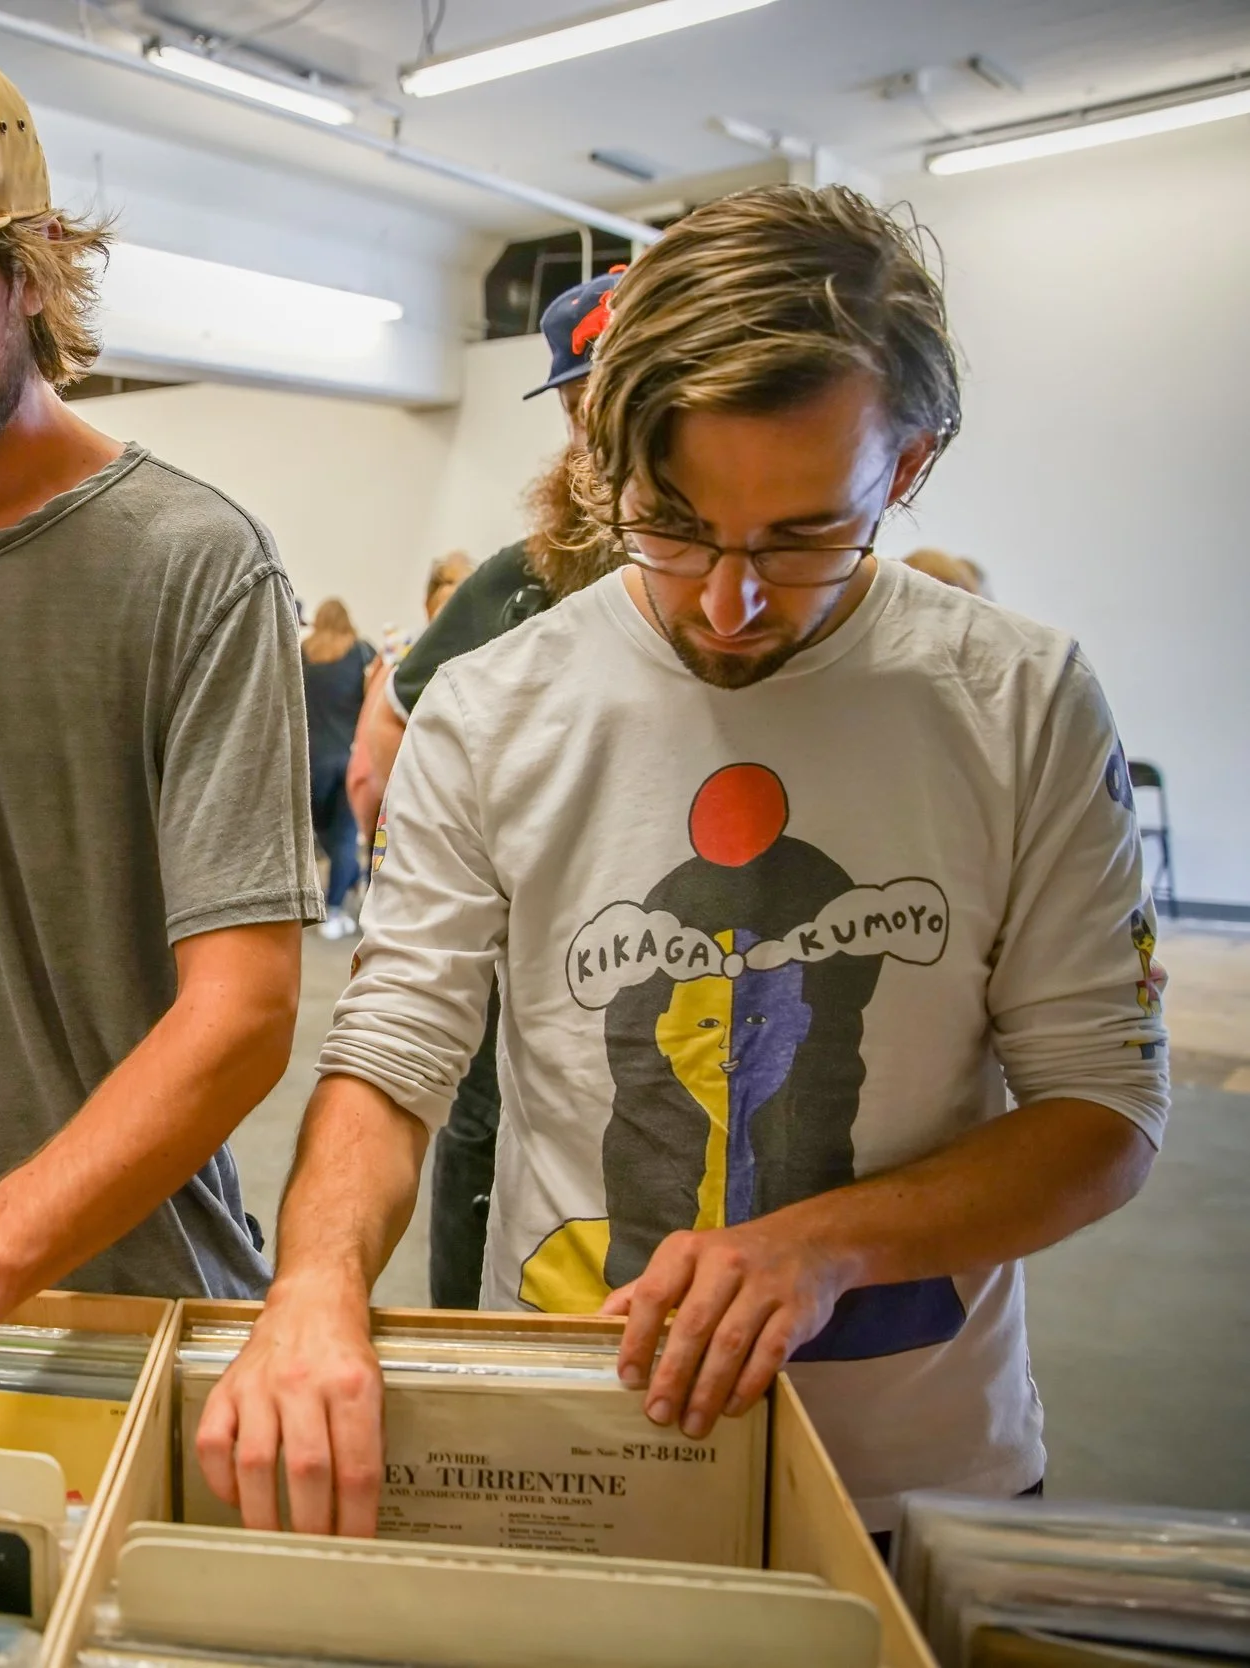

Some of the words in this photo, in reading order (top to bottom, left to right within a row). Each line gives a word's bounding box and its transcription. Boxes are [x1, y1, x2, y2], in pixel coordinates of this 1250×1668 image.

[575, 932, 711, 984] KIKAGA
[426, 1452, 490, 1465] JOYRIDE
[622, 1443, 717, 1463] ST-84201
[436, 1466, 626, 1496] TURRENTINE
[388, 1488, 410, 1496] AND
[414, 1489, 481, 1500] CONDUCTED
[485, 1493, 500, 1501] BY
[505, 1494, 545, 1504] OLIVER
[550, 1496, 593, 1506] NELSON
